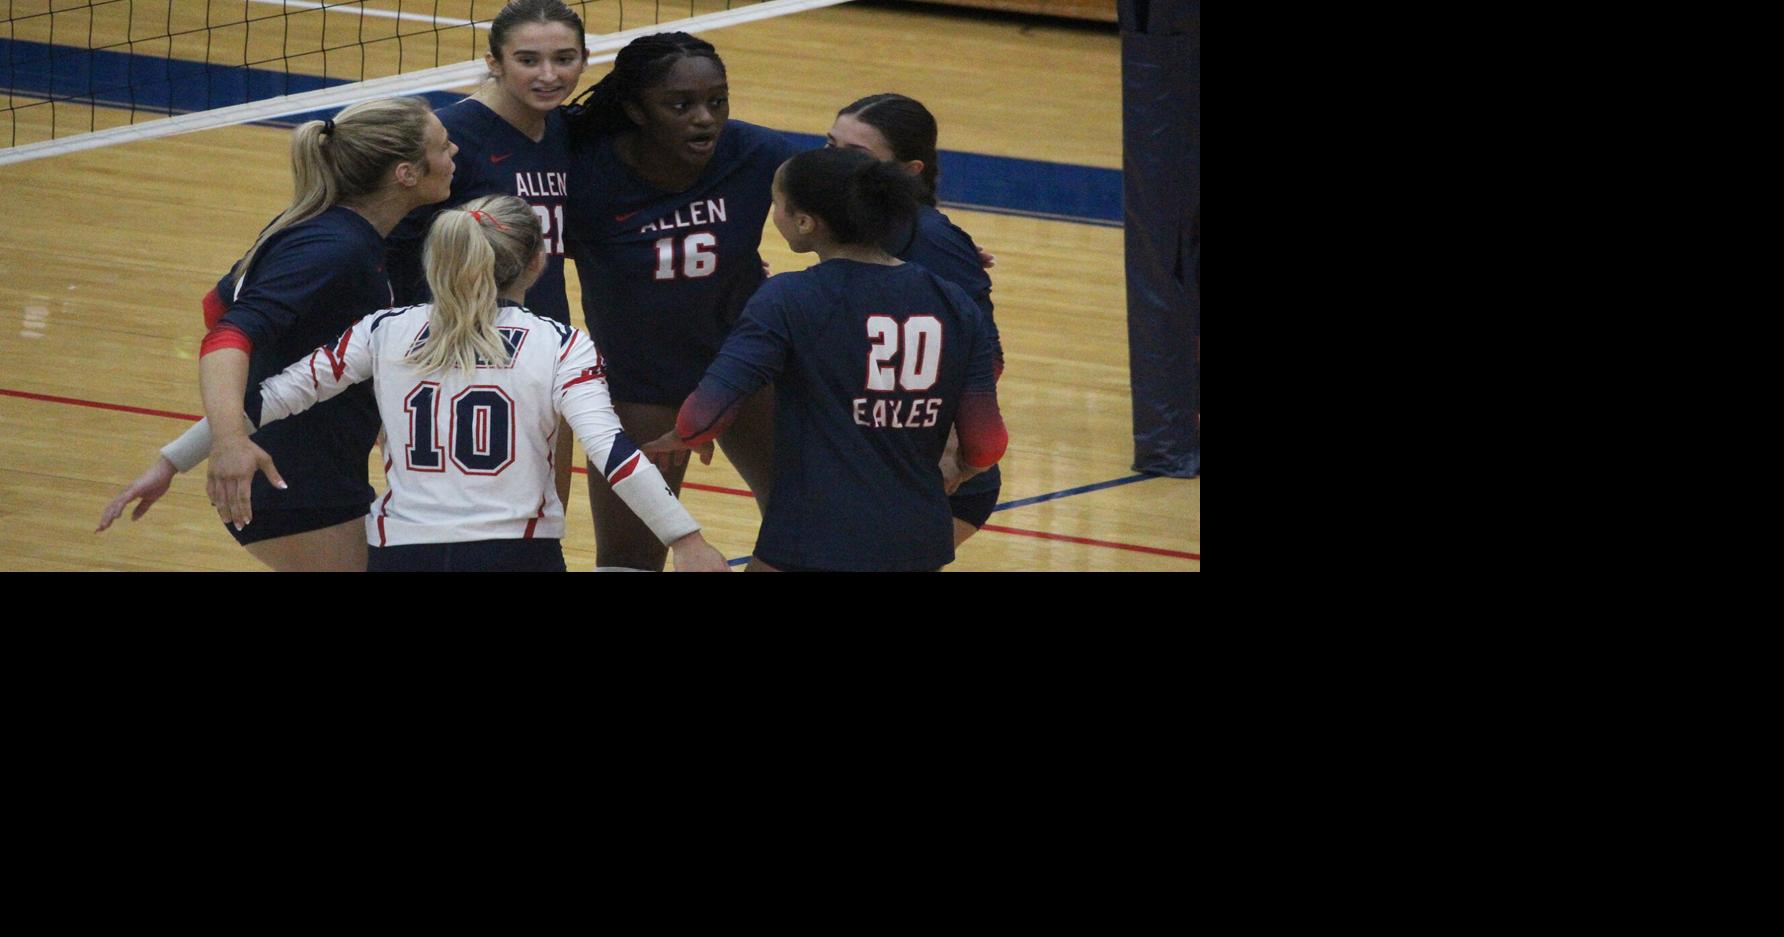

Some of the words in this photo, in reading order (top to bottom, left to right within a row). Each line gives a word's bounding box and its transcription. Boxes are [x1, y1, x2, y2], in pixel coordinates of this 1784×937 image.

[515, 171, 568, 197] ALLEN
[654, 231, 718, 281] 16
[865, 313, 944, 393] 20
[404, 380, 516, 476] 10
